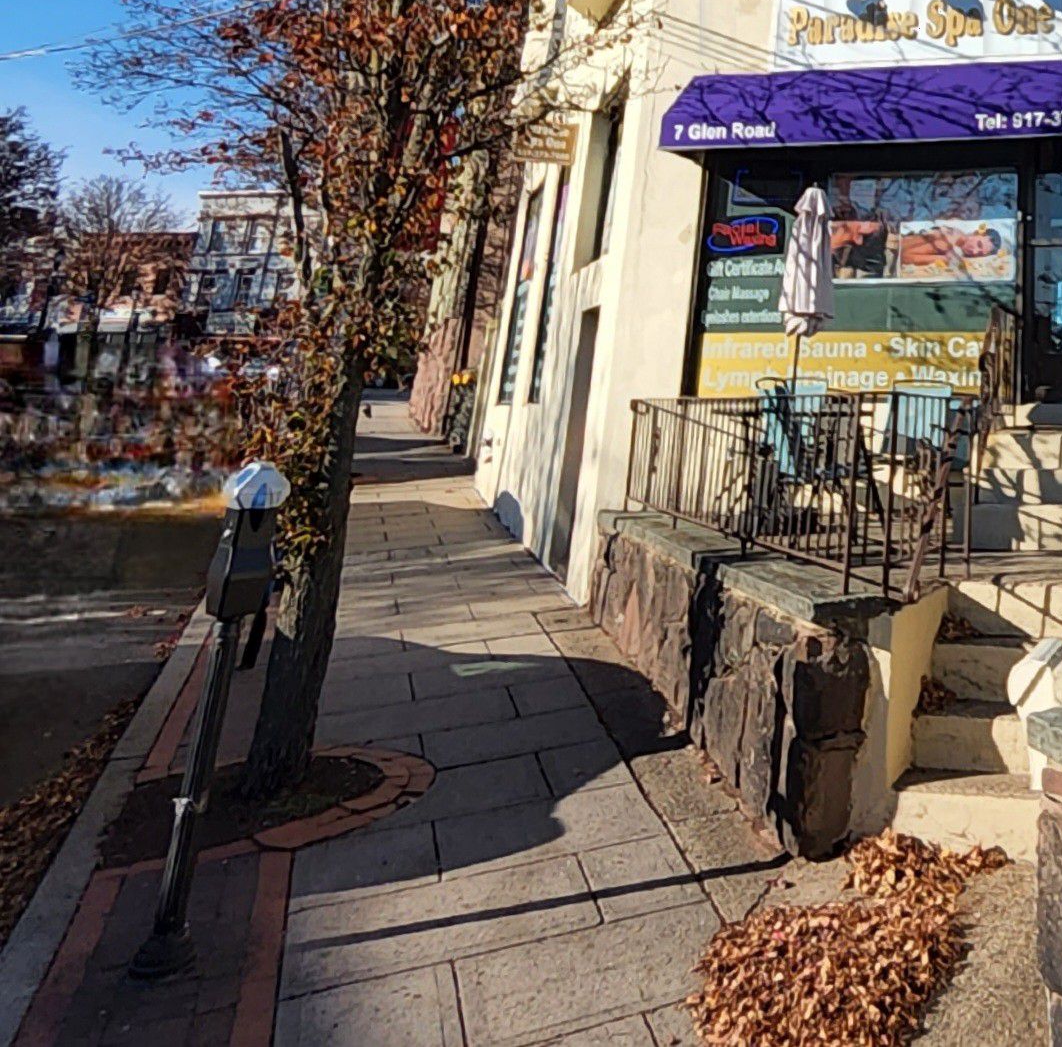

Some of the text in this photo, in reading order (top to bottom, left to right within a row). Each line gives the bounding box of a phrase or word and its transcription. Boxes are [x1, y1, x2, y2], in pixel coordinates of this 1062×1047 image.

[673, 121, 776, 141] 7 Glen Road
[974, 113, 1008, 131] Tel:
[732, 286, 770, 303] Massage
[703, 337, 789, 359] Infrared
[799, 336, 867, 359] Sauna
[888, 336, 941, 359] Skin
[910, 364, 982, 387] Waxin
